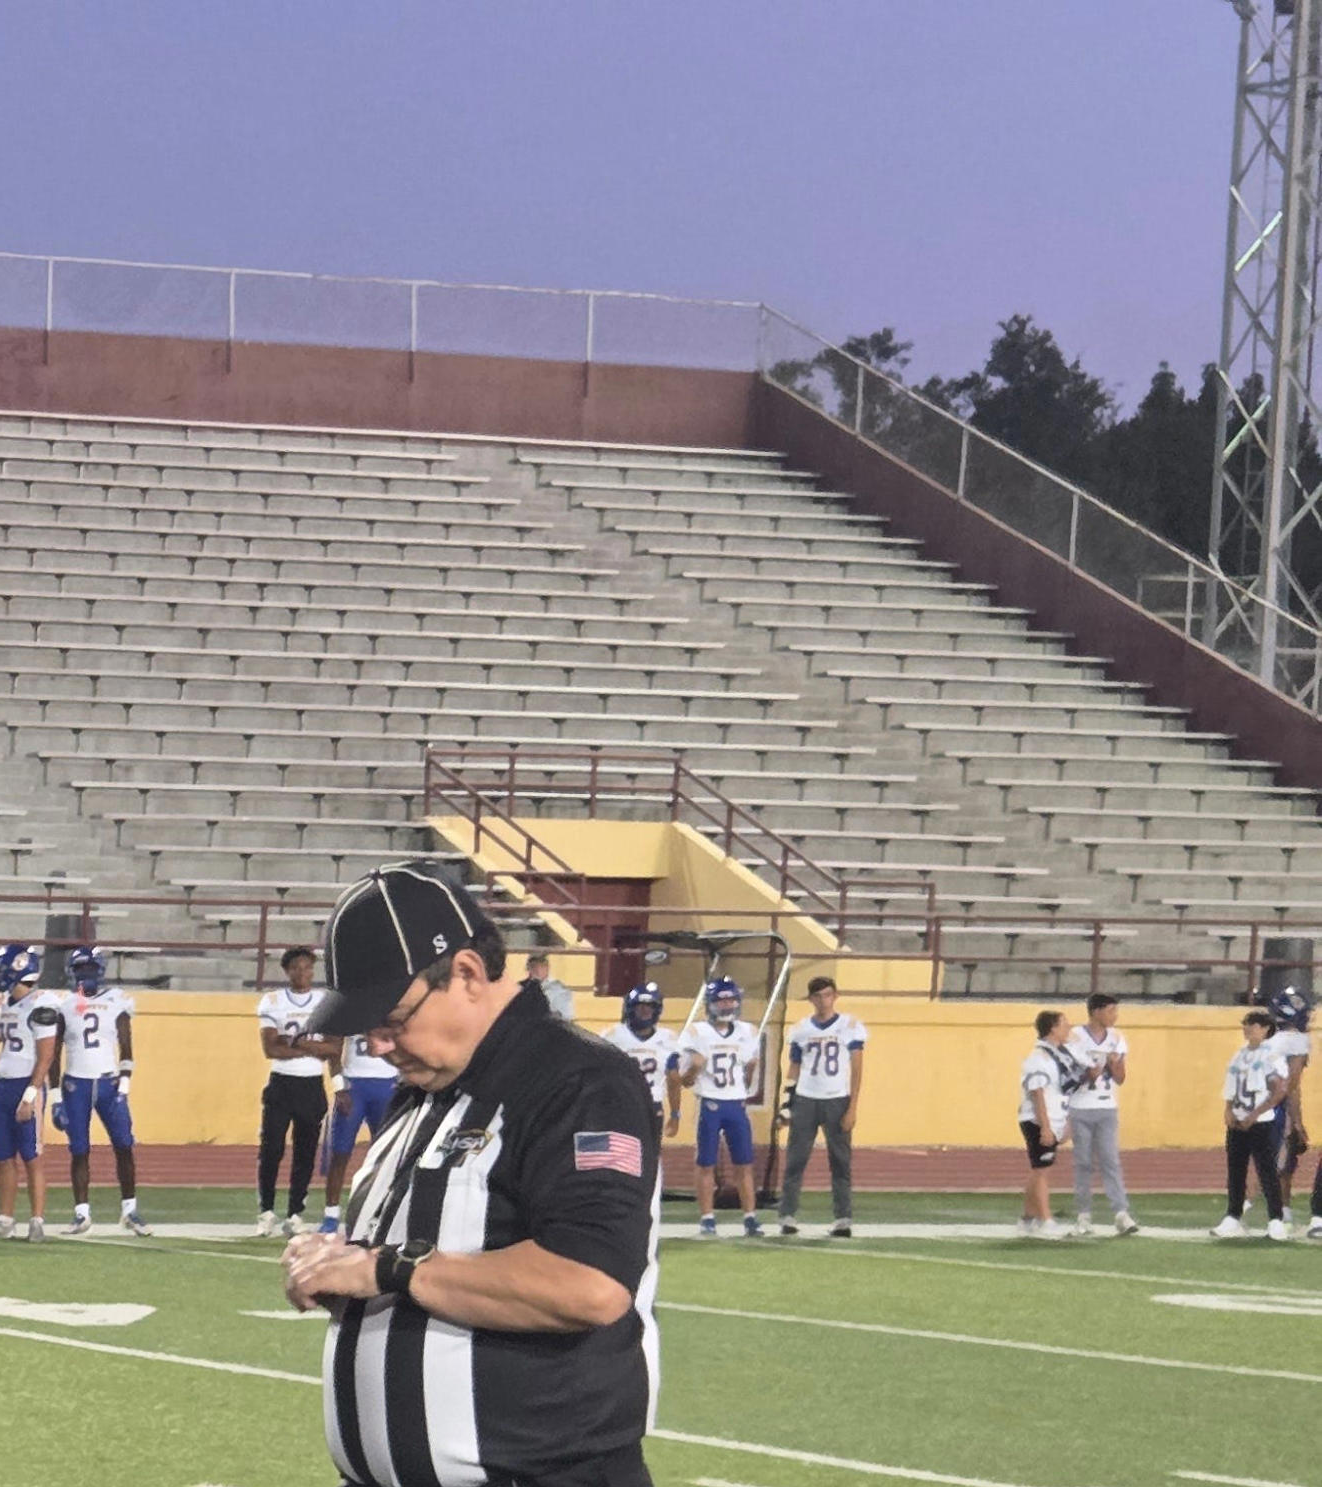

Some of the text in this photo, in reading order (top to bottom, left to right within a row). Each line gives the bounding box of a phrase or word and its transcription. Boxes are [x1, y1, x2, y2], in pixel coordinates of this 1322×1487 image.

[83, 1013, 101, 1049] 2
[712, 1053, 737, 1089] 51
[806, 1041, 840, 1077] 78
